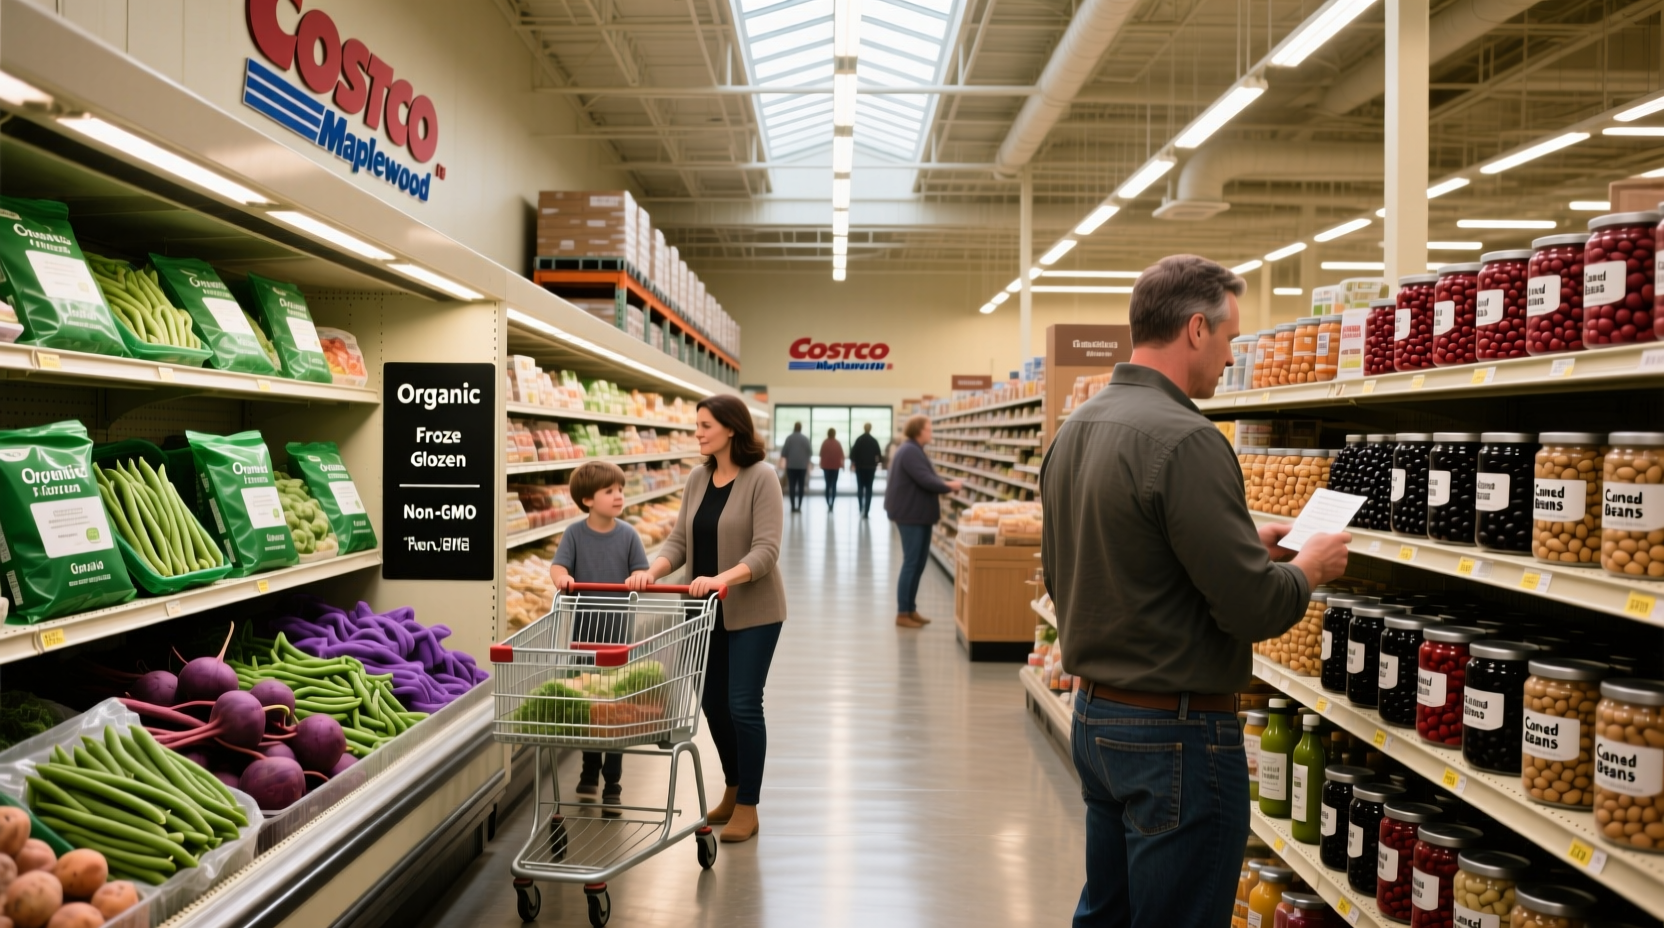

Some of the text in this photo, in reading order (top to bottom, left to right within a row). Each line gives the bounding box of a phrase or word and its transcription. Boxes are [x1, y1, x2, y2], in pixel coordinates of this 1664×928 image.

[246, 0, 438, 163] COSTCO
[318, 109, 431, 202] Maplewood
[789, 337, 890, 360] COSTCO
[397, 382, 481, 410] Organic
[416, 427, 462, 443] Froze
[410, 451, 467, 467] Glozen
[403, 504, 477, 520] Non-GMO
